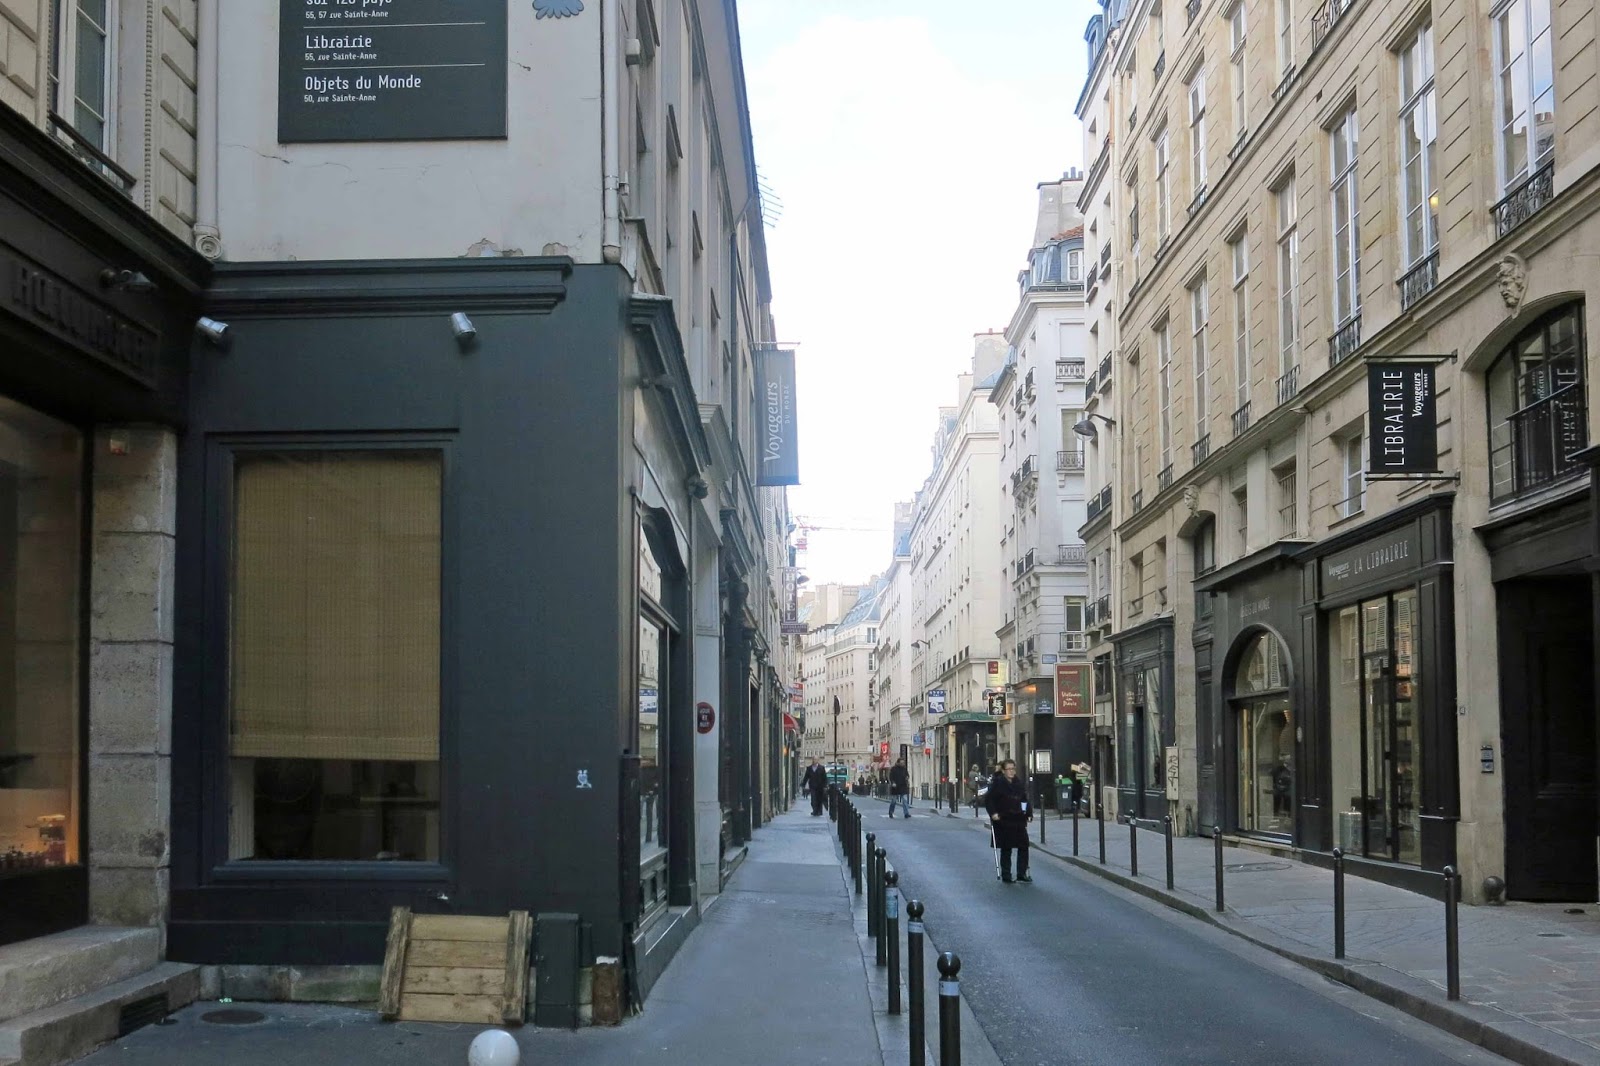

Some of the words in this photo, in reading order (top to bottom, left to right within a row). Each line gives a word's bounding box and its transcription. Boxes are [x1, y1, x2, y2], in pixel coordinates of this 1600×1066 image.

[305, 11, 316, 19] 55,
[318, 11, 327, 19] 57
[344, 10, 389, 18] Sainte-Anne
[306, 35, 372, 49] Librairie
[305, 53, 316, 61] 55,
[332, 52, 377, 61] Sainte-Anne
[305, 76, 349, 93] Objets
[355, 76, 372, 89] du
[378, 74, 422, 89] Monde
[304, 94, 315, 103] 50,
[331, 93, 377, 102] Sainte-Anne
[1411, 372, 1424, 417] Voyageurs
[763, 381, 783, 463] Voyageurs
[1382, 371, 1405, 466] LIBRAIRIE
[1354, 557, 1363, 574] LA
[1366, 540, 1409, 570] LIBRAIRIE
[785, 572, 796, 621] HOTEL
